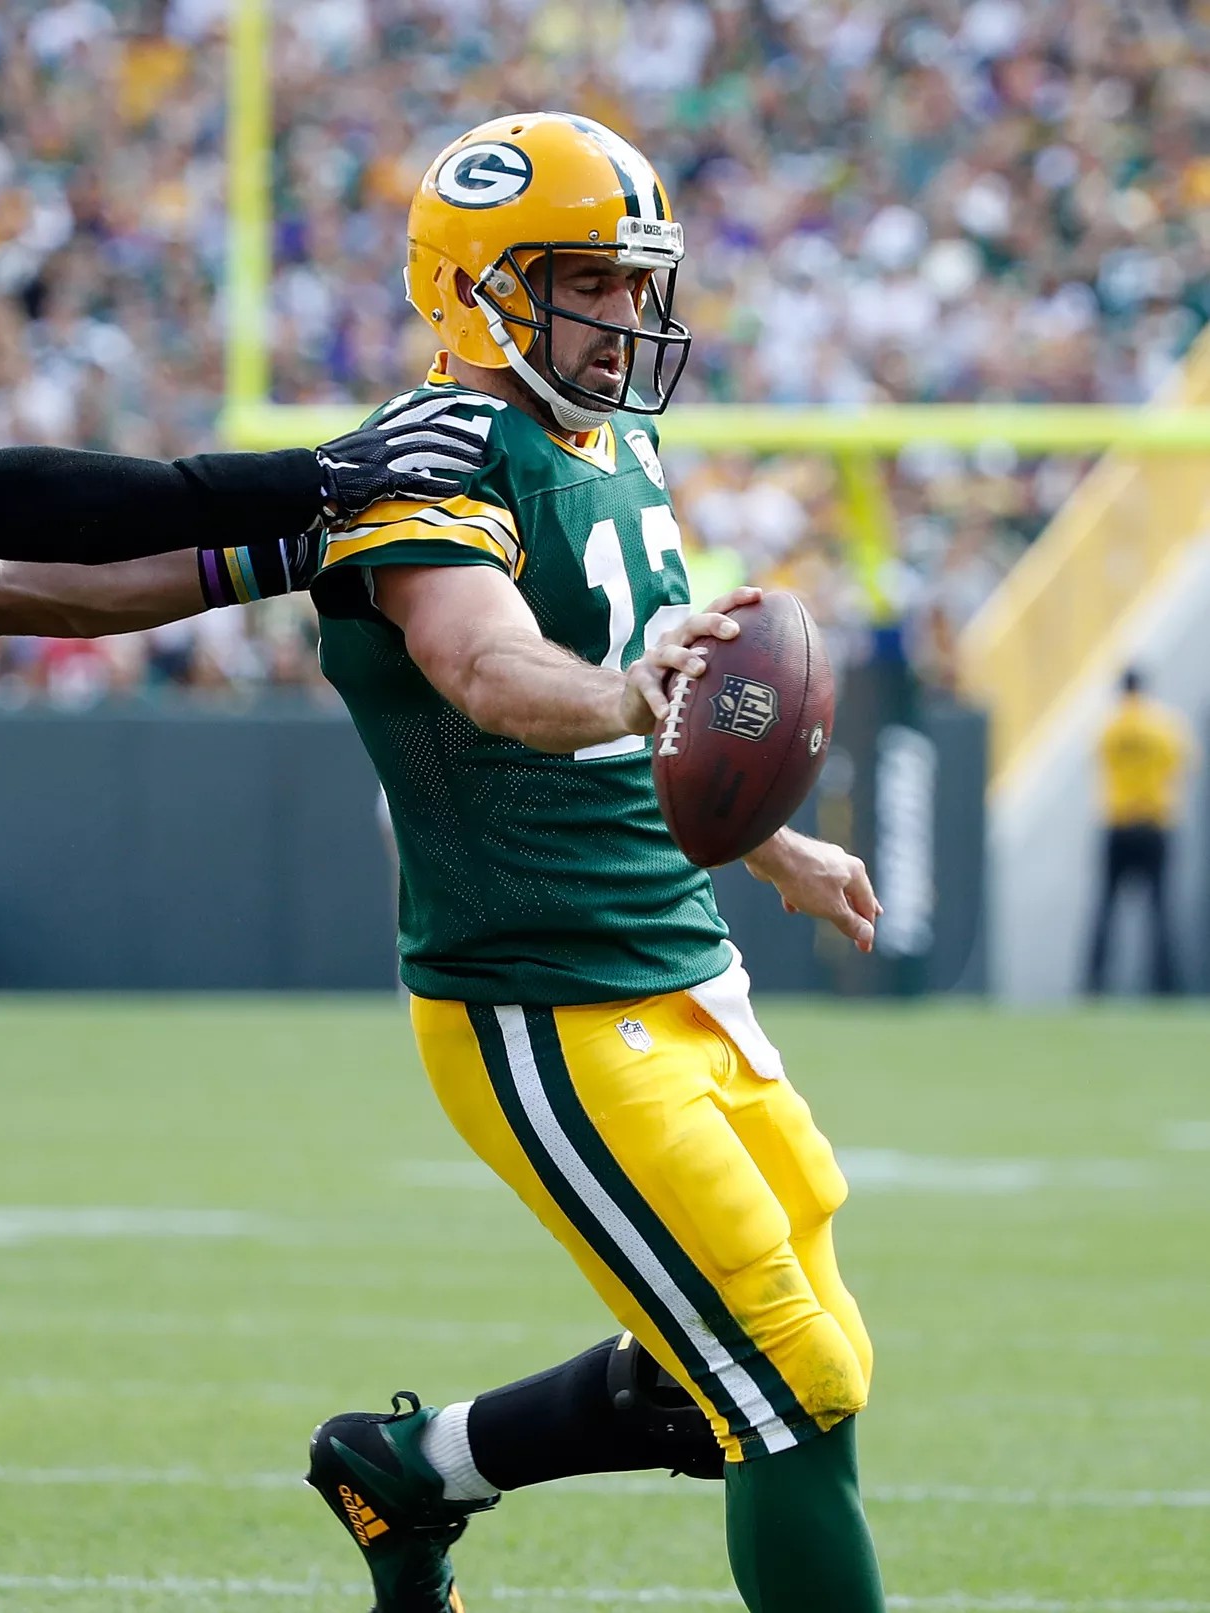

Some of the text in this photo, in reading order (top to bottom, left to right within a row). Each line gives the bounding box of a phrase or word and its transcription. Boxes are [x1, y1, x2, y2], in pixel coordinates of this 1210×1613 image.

[437, 143, 528, 204] G
[735, 688, 771, 736] NFL
[338, 1484, 370, 1547] adidas
